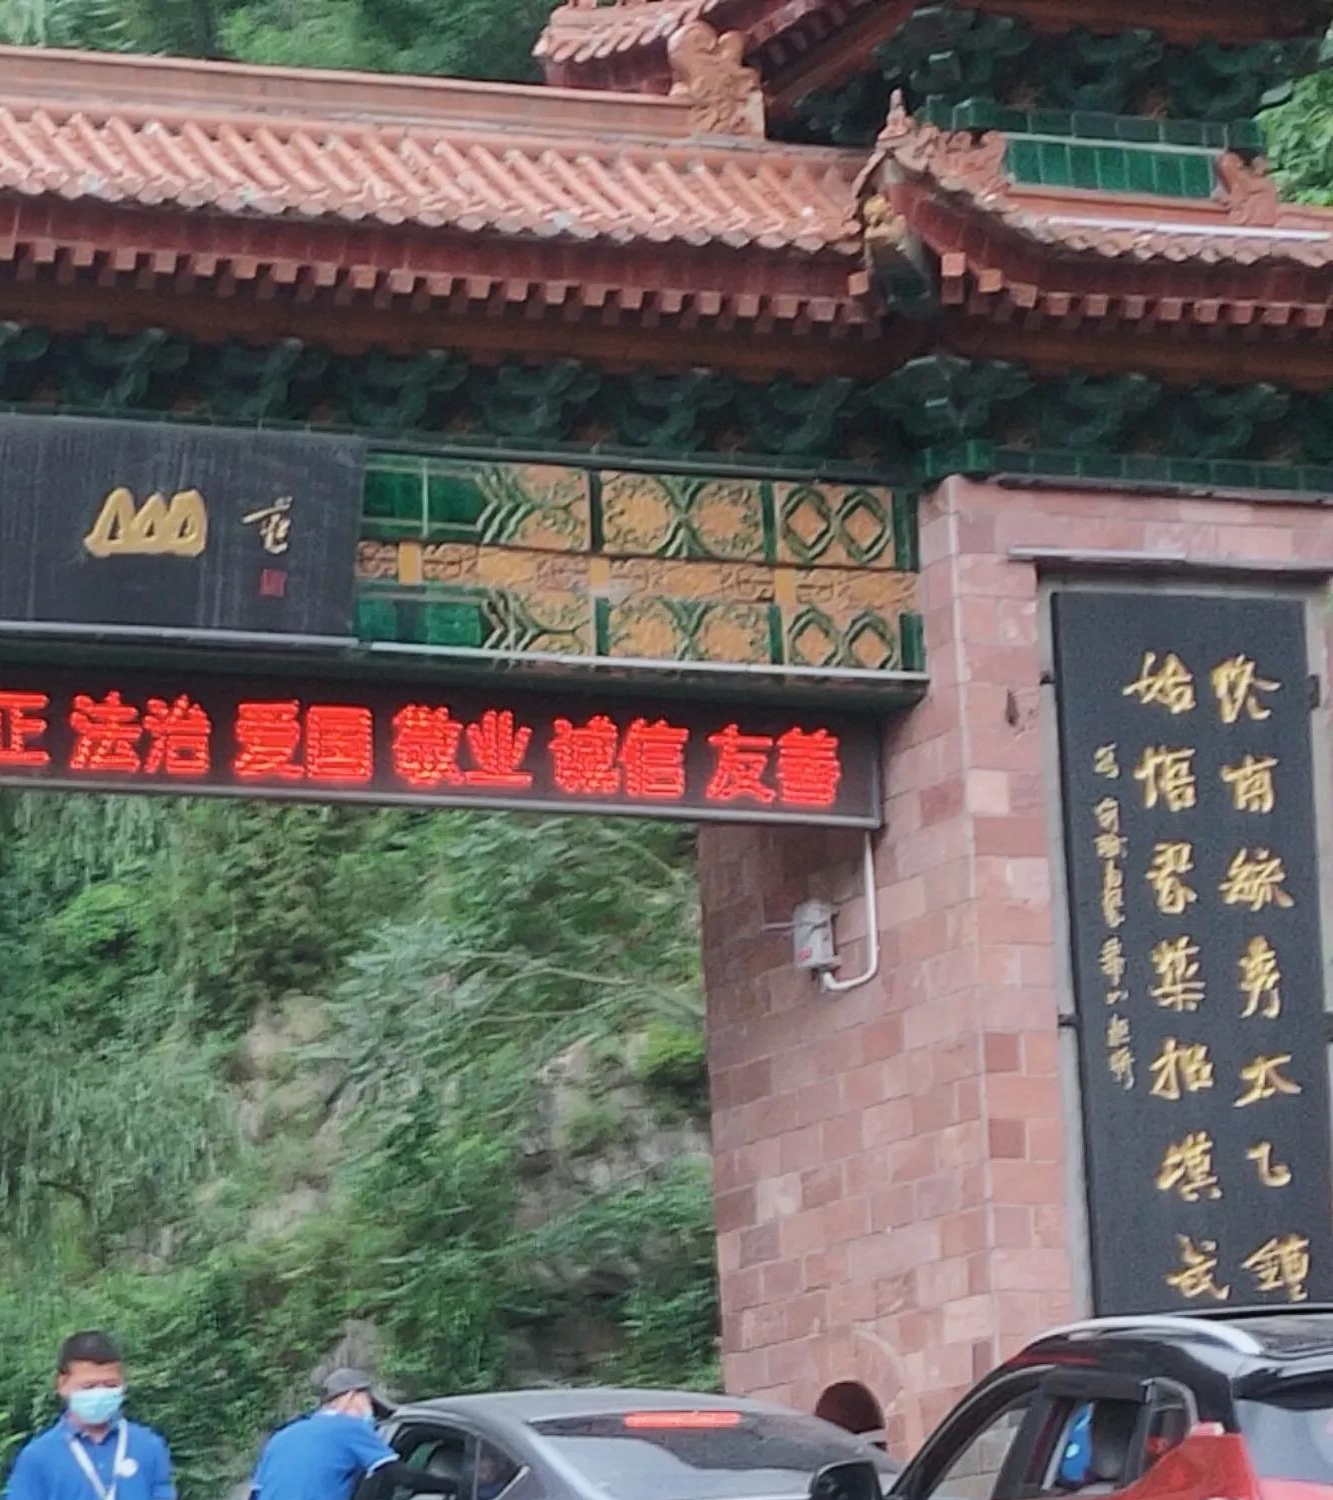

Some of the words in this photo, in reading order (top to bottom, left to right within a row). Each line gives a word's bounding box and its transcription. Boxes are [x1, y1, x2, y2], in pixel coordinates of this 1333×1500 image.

[69, 690, 212, 777] 法治
[233, 698, 374, 785] 爱国
[390, 704, 534, 790] 敬业
[546, 713, 690, 801] 诚信
[704, 723, 843, 809] 友善
